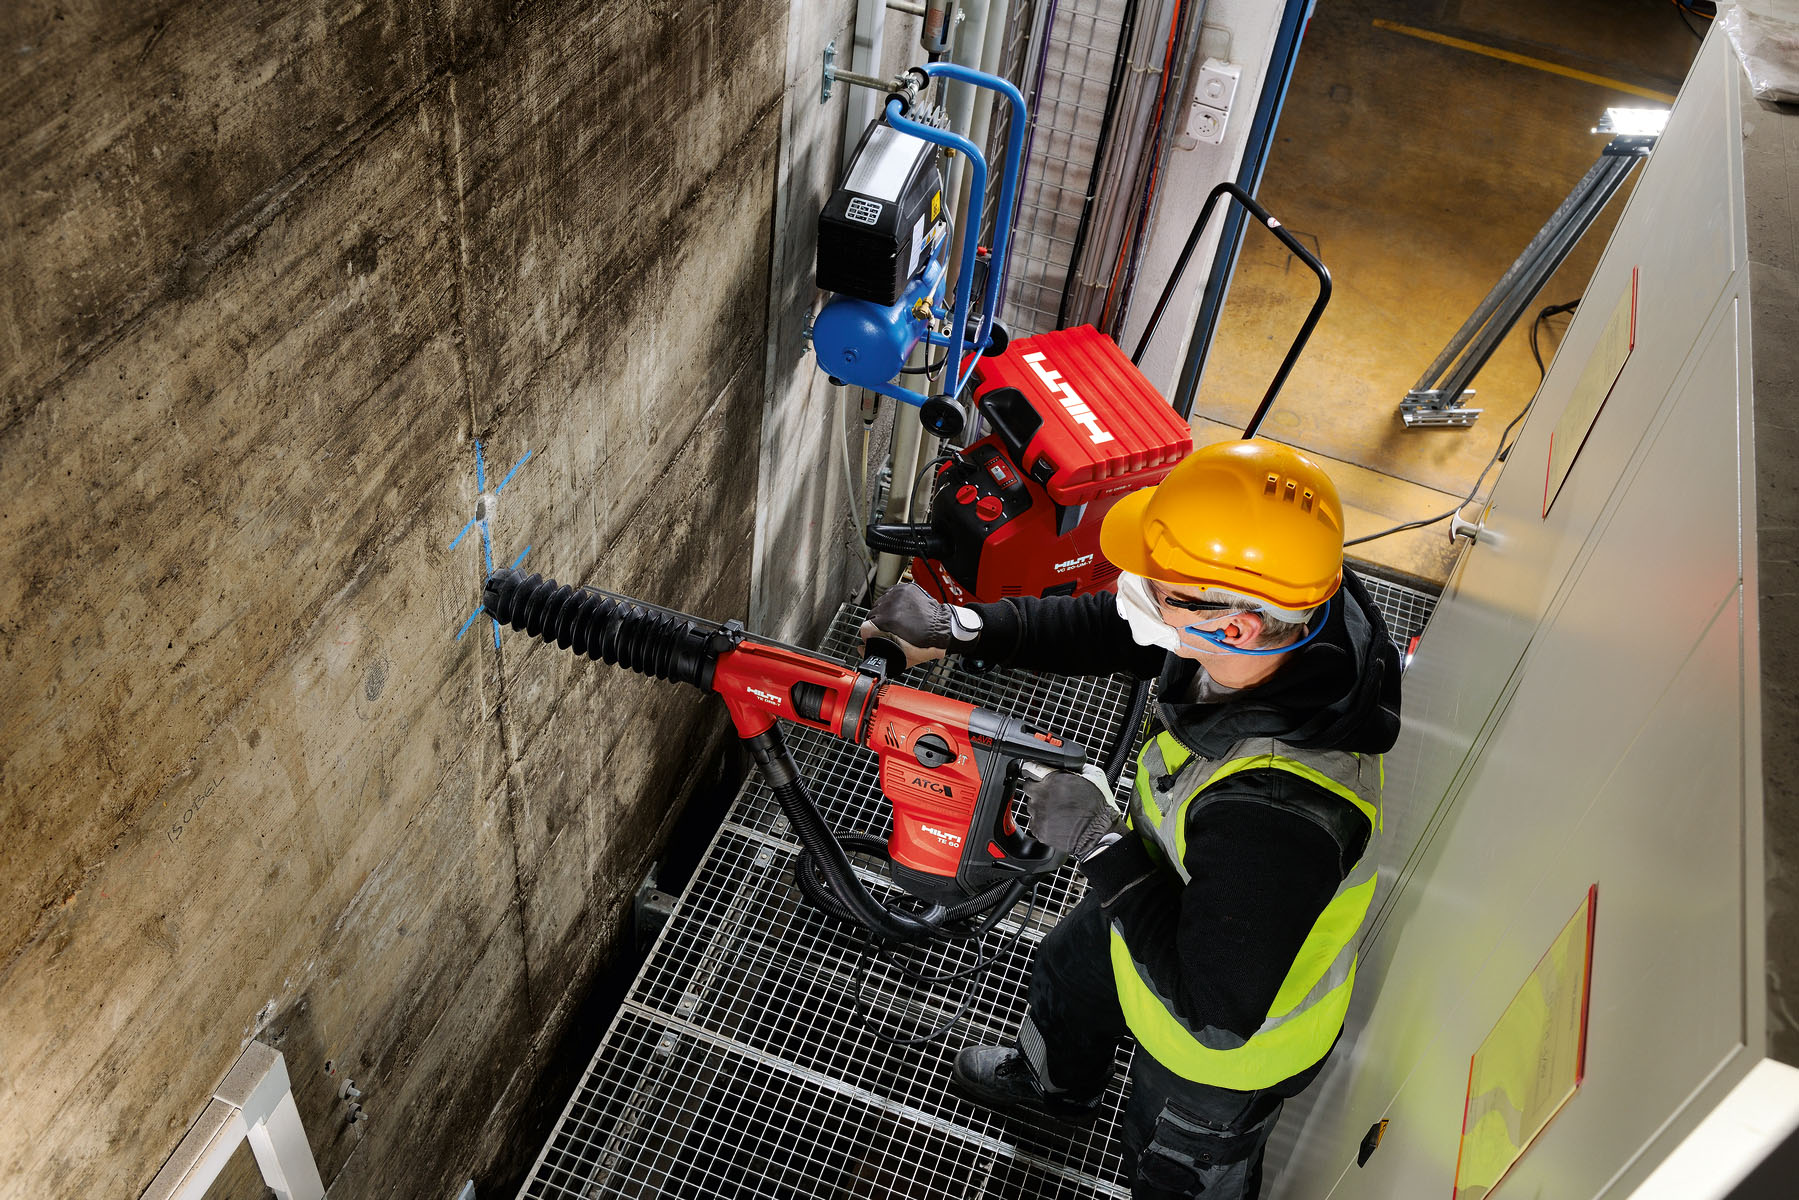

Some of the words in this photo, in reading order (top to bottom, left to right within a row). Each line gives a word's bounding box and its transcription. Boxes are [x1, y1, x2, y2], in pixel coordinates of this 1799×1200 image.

[1022, 351, 1115, 445] HILTI
[1054, 553, 1094, 570] HILTI
[746, 686, 782, 703] HILTI
[977, 735, 993, 745] AVR
[921, 824, 962, 843] HILTI
